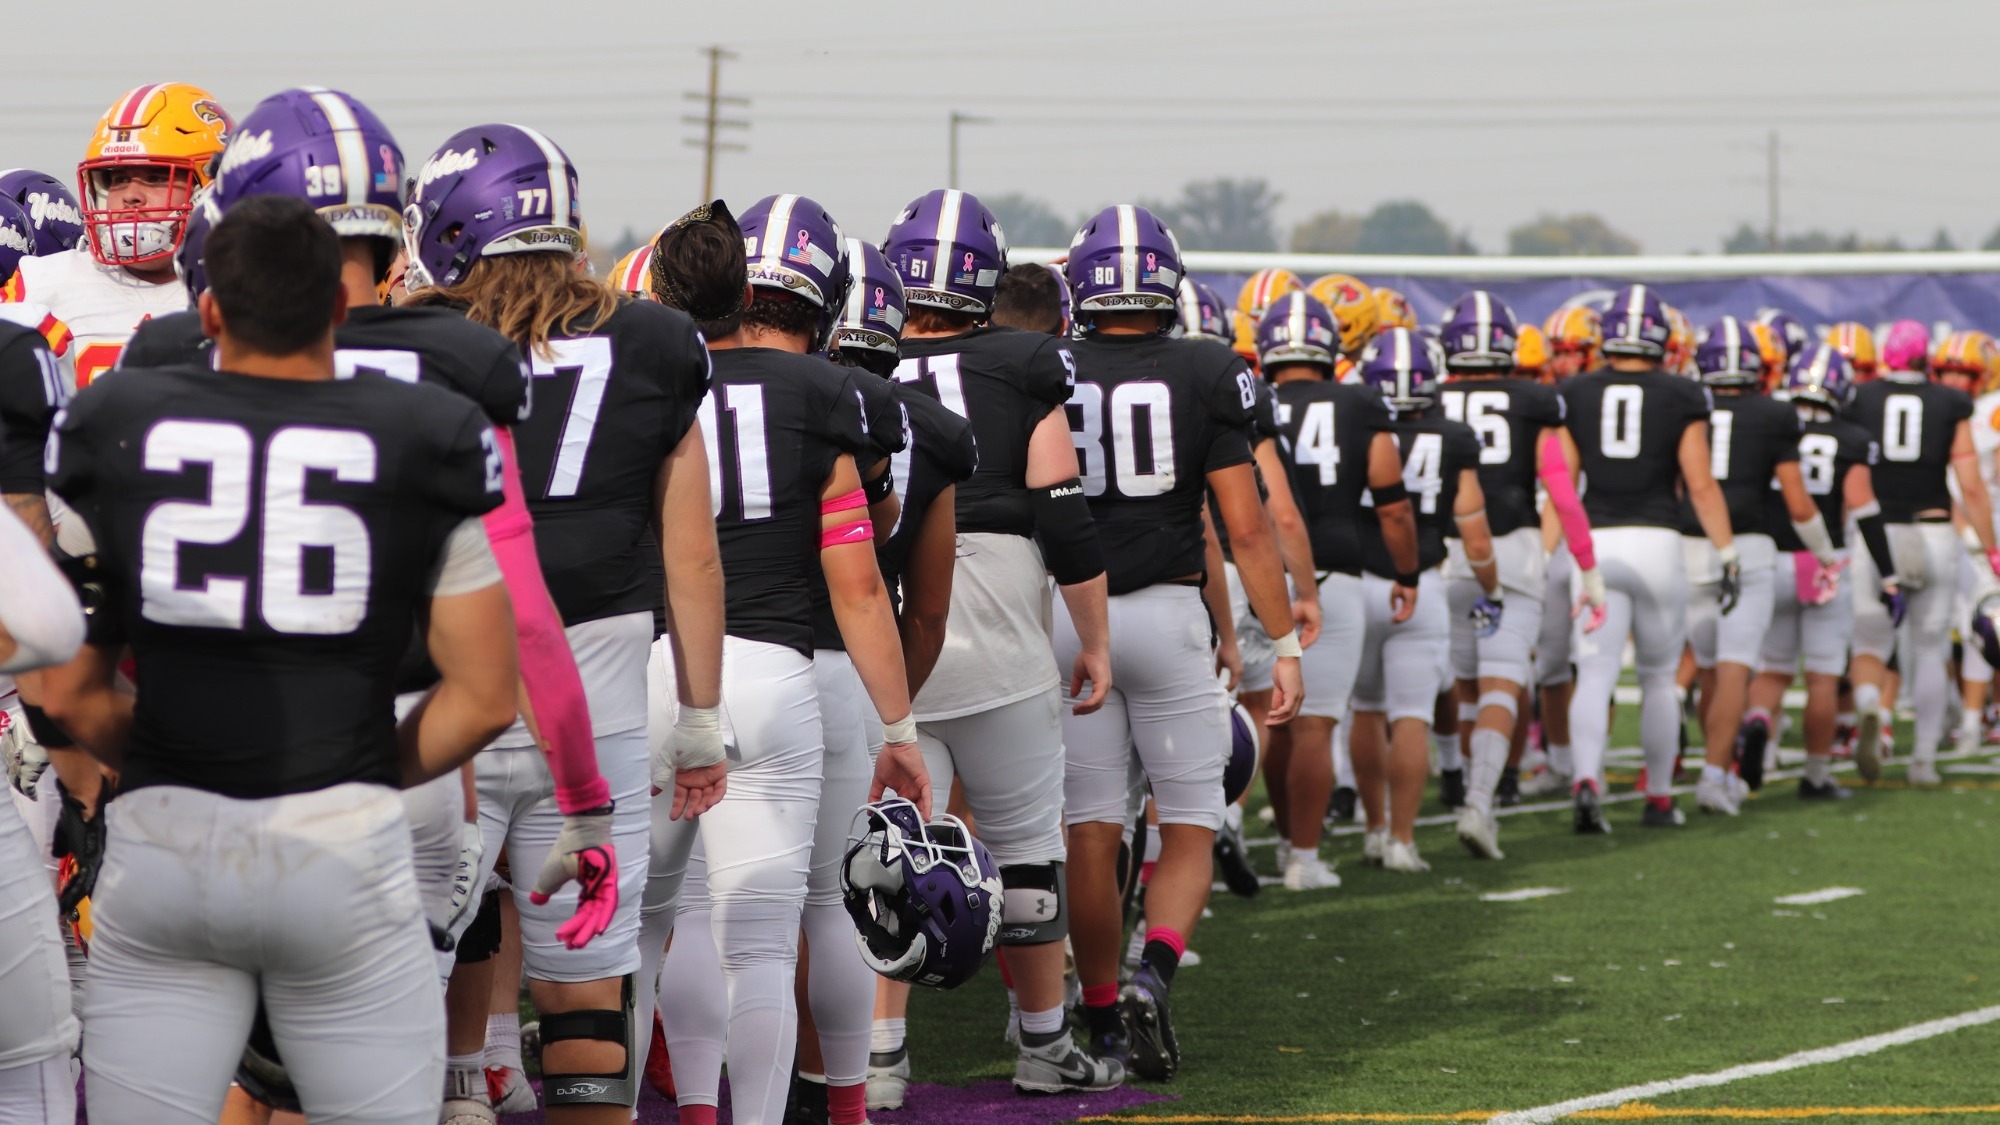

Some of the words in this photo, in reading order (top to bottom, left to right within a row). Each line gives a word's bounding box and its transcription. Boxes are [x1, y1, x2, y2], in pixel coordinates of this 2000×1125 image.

[304, 165, 341, 197] 39
[517, 188, 547, 216] 77
[330, 208, 389, 222] DAHO
[746, 270, 796, 285] DAHO
[910, 258, 928, 279] 51
[1095, 266, 1115, 285] 80
[911, 291, 962, 307] IDAHO
[1104, 296, 1155, 306] IDAHO
[1602, 384, 1643, 458] 0
[1883, 394, 1924, 462] 0
[141, 419, 377, 635] 26
